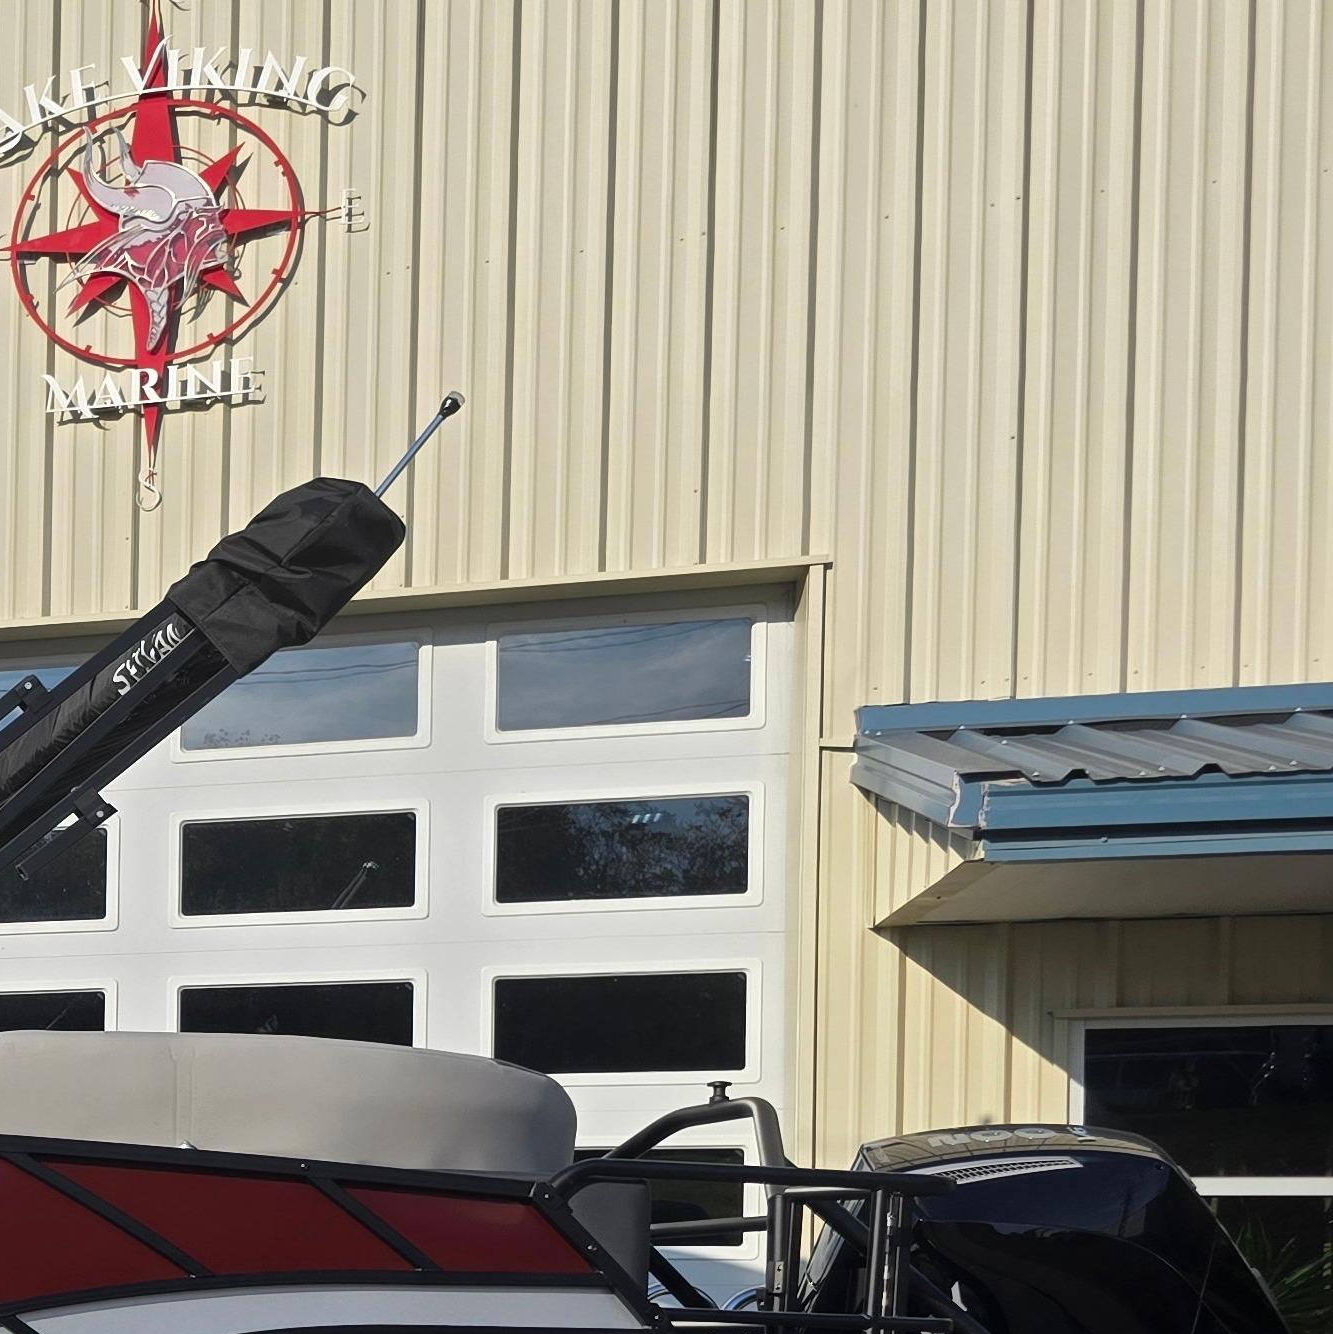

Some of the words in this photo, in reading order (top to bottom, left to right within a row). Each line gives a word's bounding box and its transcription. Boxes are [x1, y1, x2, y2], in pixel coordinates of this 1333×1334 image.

[120, 34, 357, 111] VIKING
[339, 188, 366, 226] E
[40, 355, 258, 414] MARINE
